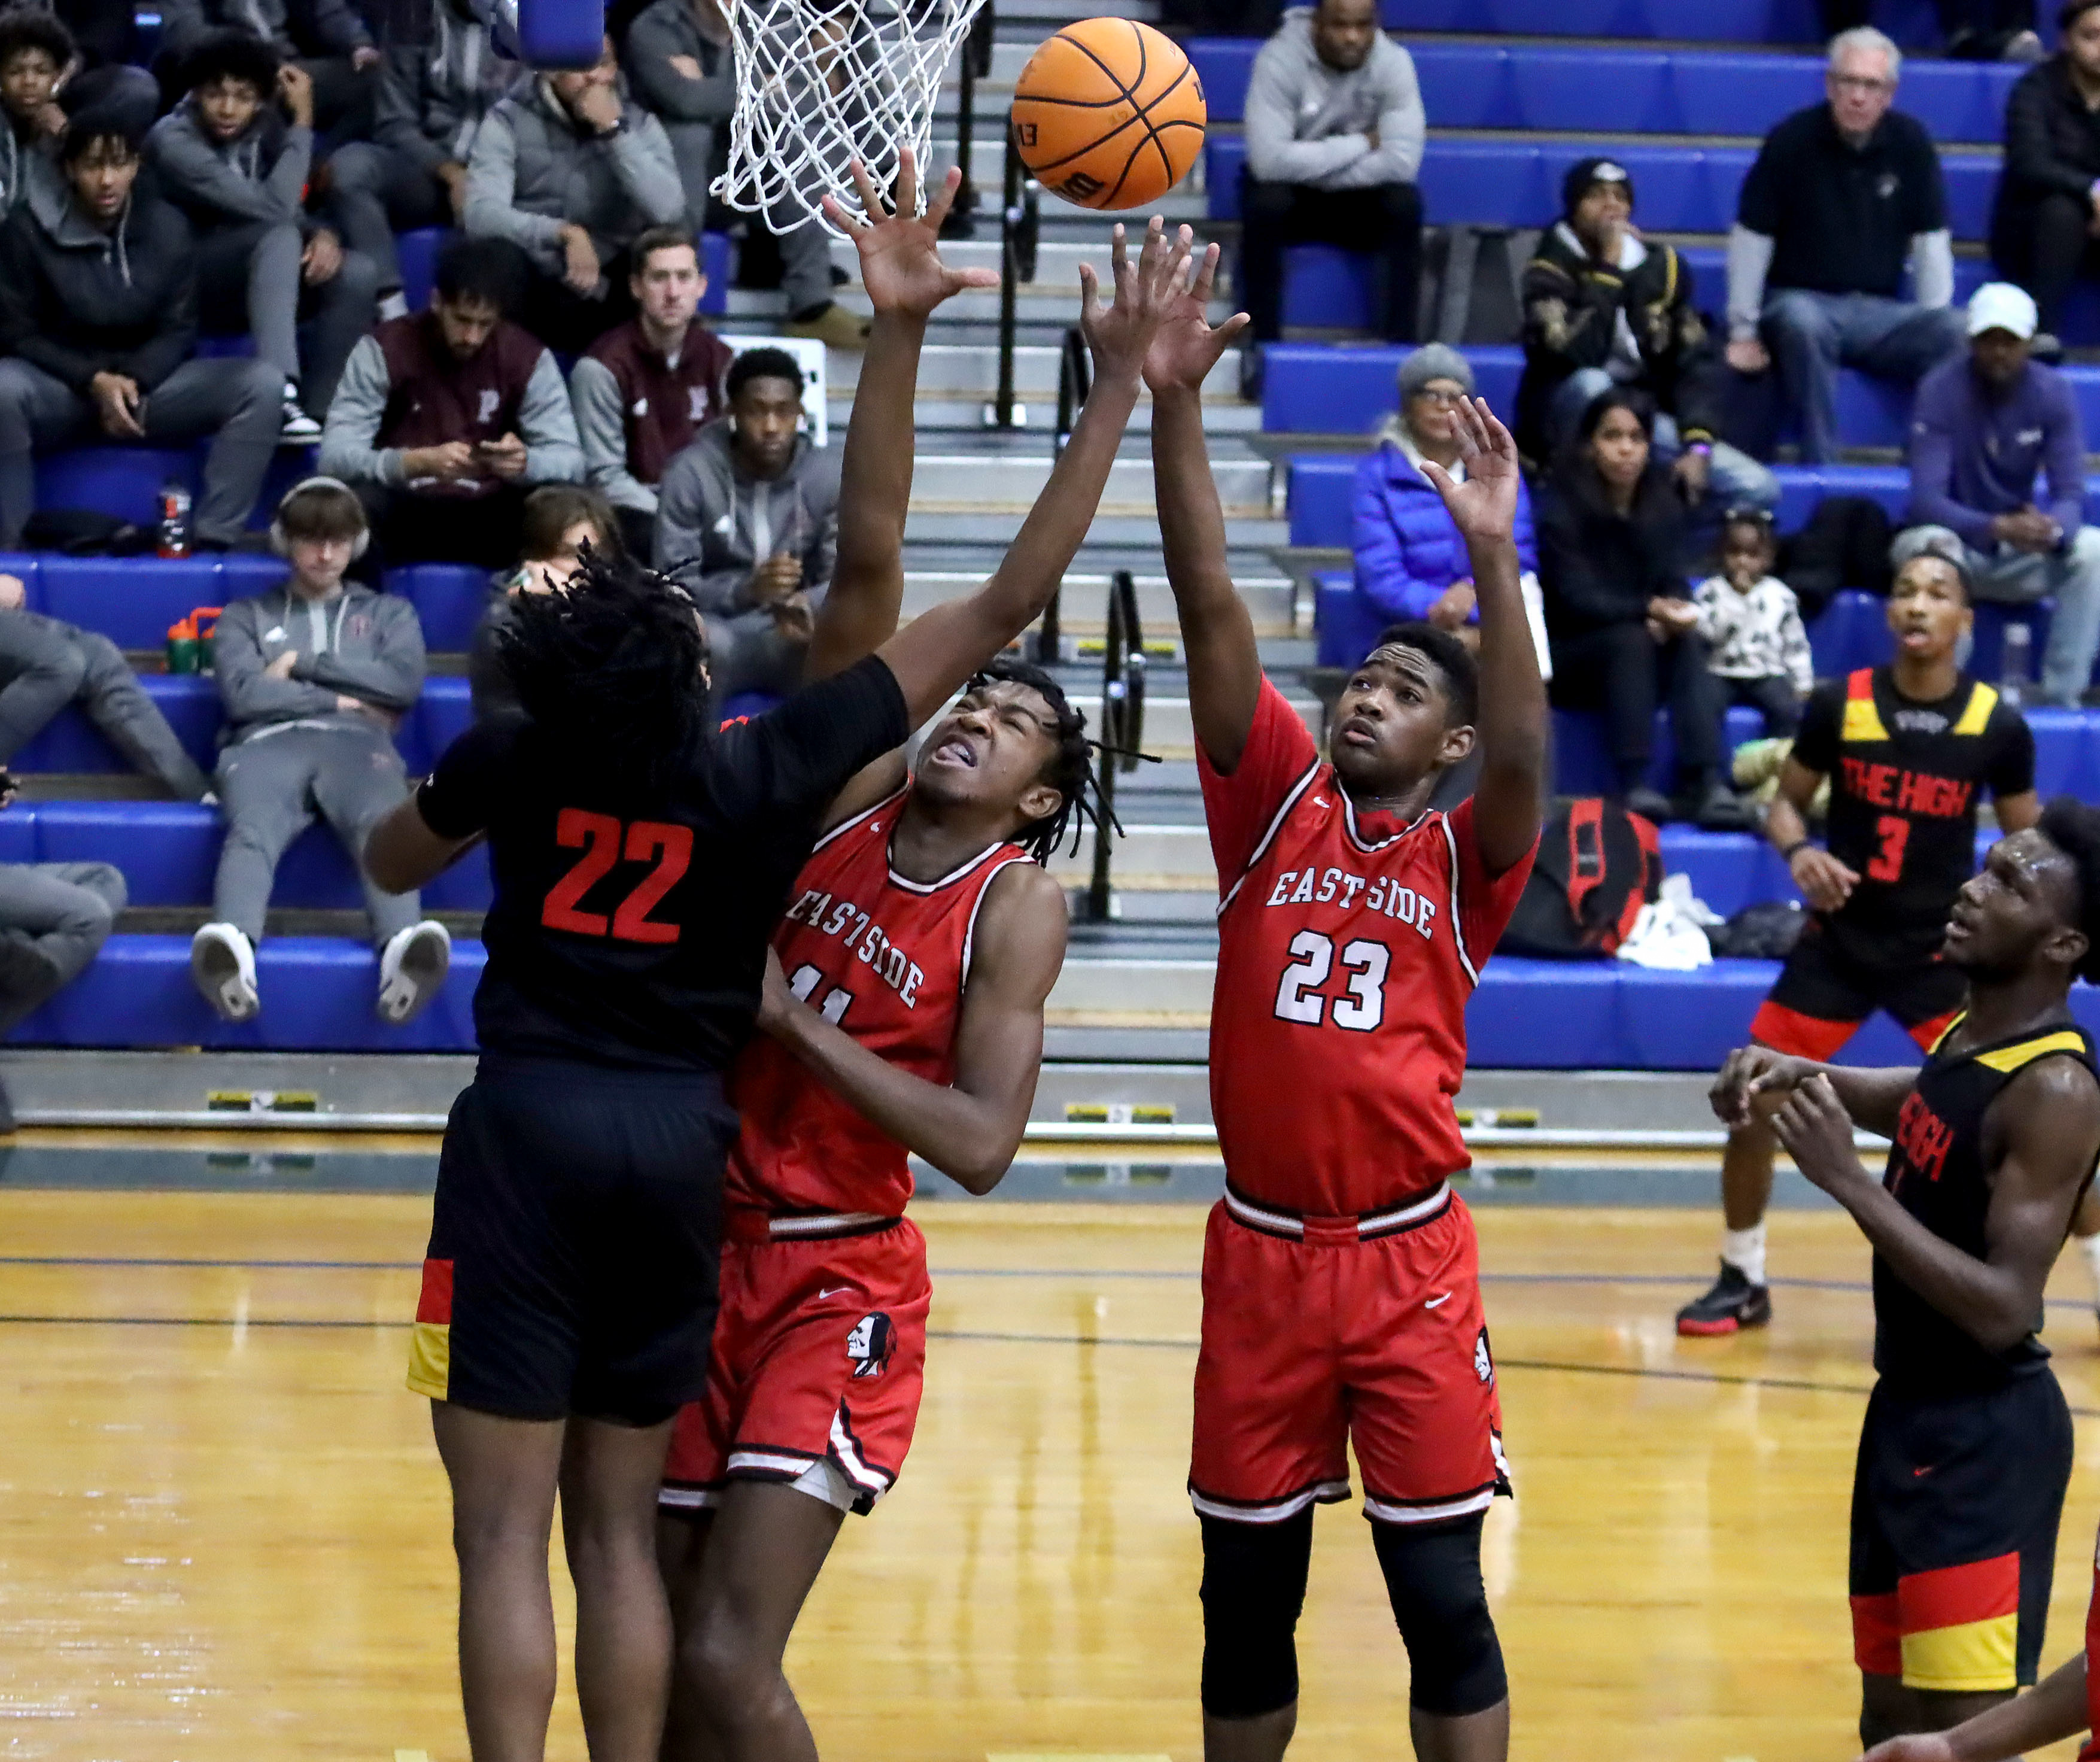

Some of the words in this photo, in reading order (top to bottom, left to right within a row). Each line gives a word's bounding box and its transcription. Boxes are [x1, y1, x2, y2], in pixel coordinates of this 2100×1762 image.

[1842, 757, 1898, 807] THE
[1897, 770, 1972, 817] HIGH
[541, 808, 694, 944] 22
[1868, 815, 1910, 883] 3
[1273, 928, 1393, 1033] 23
